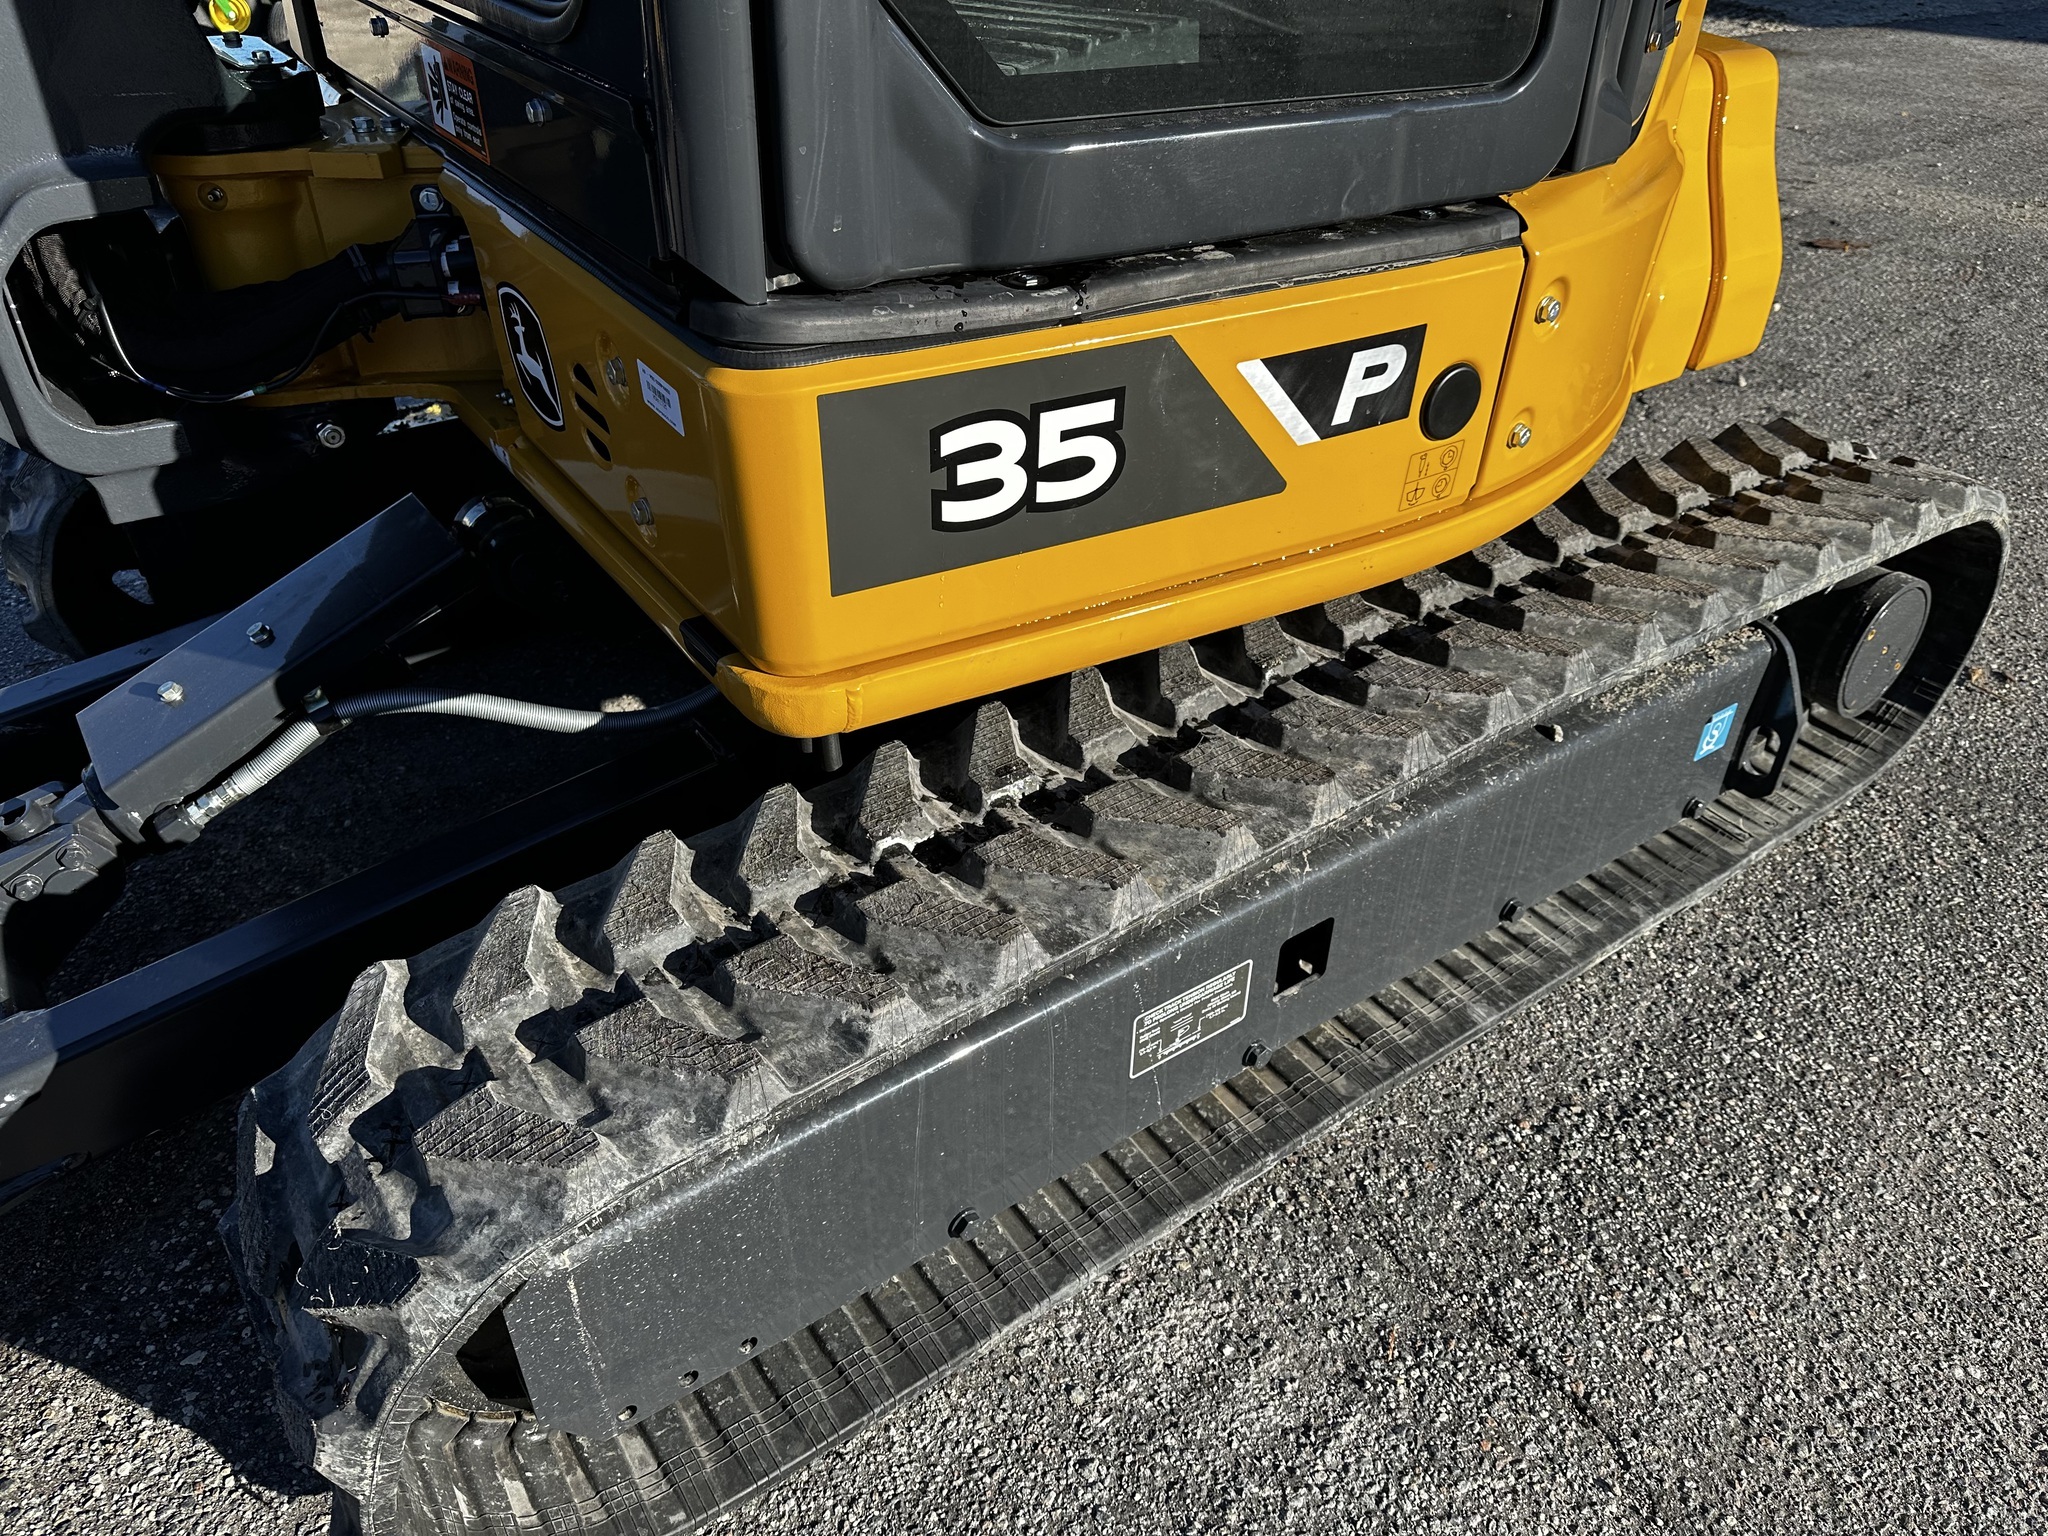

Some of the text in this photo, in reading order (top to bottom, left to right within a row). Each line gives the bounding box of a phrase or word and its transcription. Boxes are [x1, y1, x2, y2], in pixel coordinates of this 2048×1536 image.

[448, 60, 474, 85] WARNING
[447, 80, 473, 104] STAY CLEAR
[934, 390, 1121, 528] 35
[1144, 1008, 1164, 1021] CHECK
[1164, 999, 1183, 1011] TRACK
[1182, 986, 1205, 1002] TENSION
[1205, 970, 1237, 990] REGULARLY
